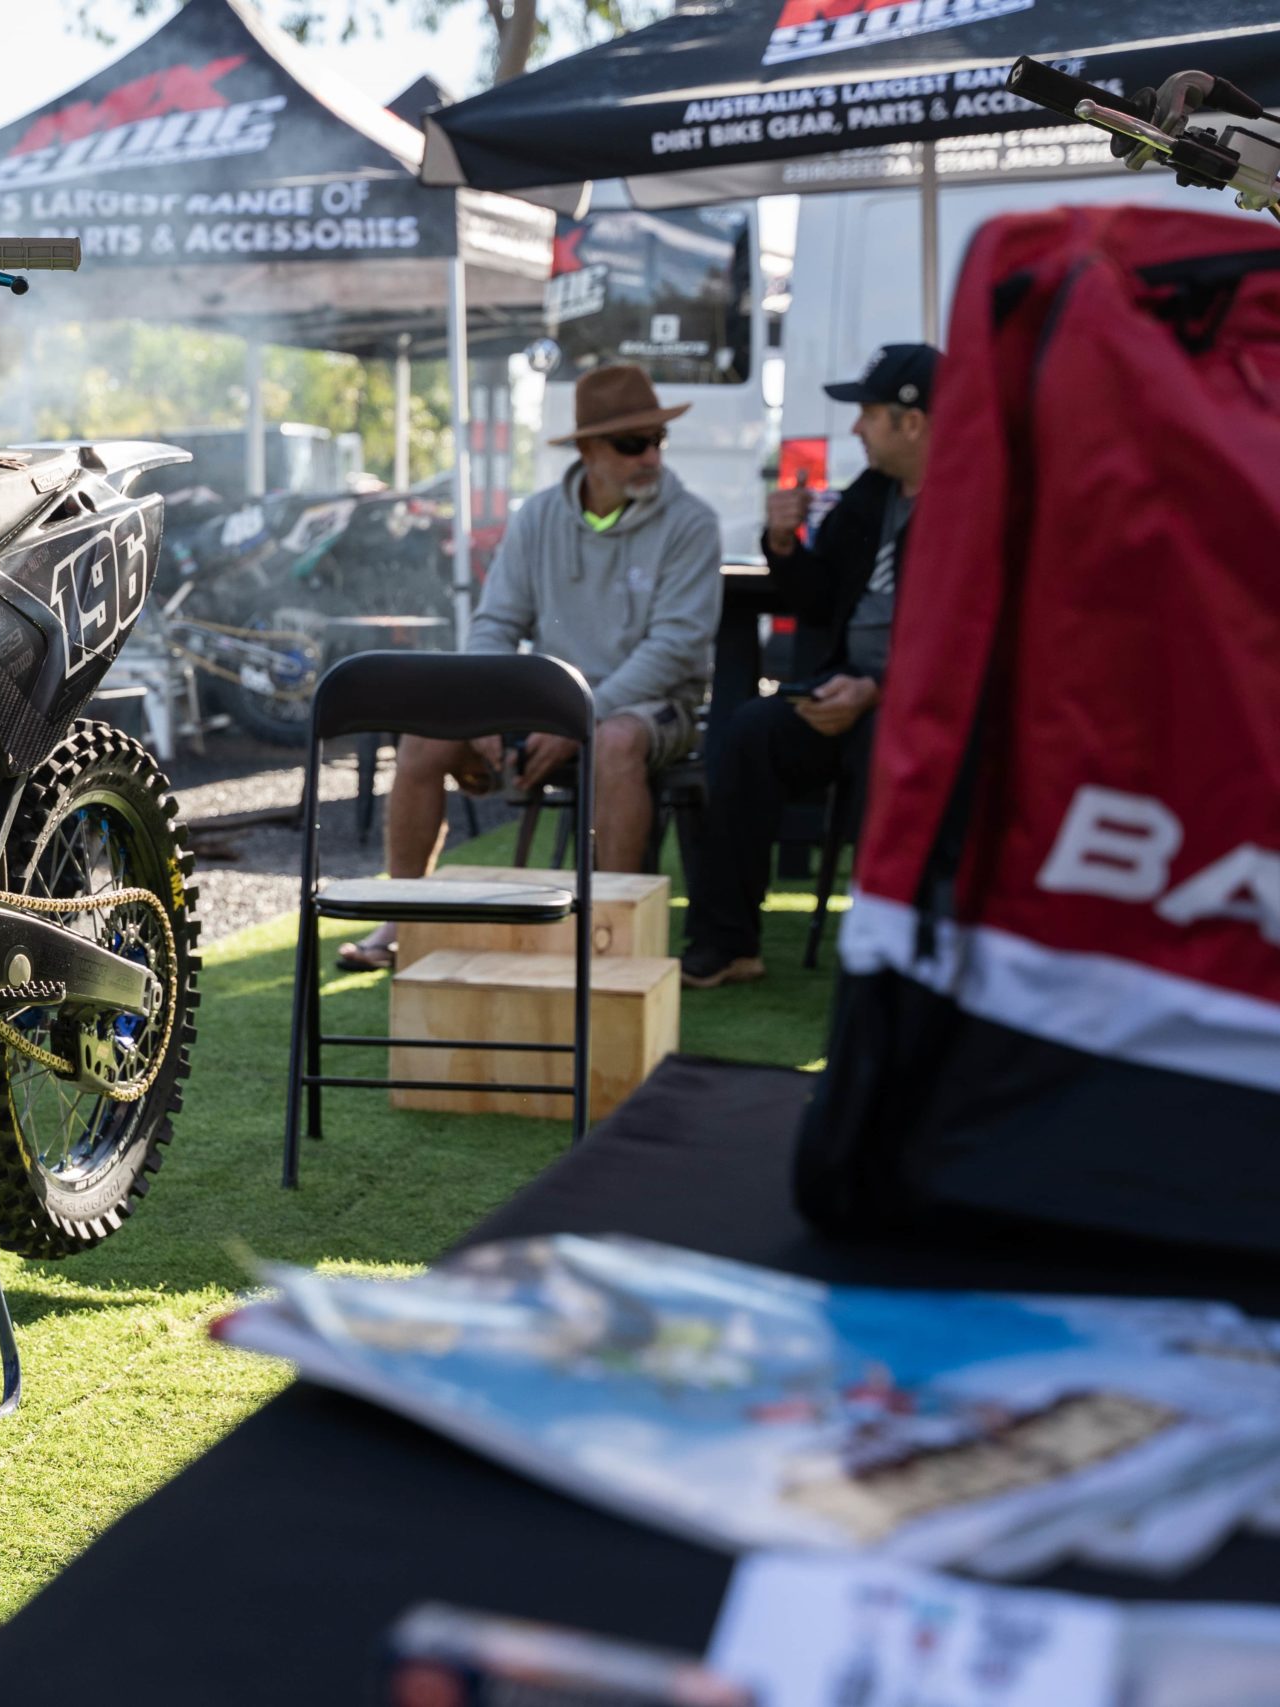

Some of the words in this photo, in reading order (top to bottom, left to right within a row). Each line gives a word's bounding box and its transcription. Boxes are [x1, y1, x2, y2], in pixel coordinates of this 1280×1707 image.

[683, 84, 837, 124] AUSTRALIA'S
[841, 73, 951, 104] LARGEST
[652, 126, 706, 155] DIRT
[708, 119, 764, 147] BIKE
[767, 110, 843, 140] GEAR,
[847, 99, 925, 131] PARTS
[929, 97, 950, 122] &
[32, 188, 180, 219] LARGEST
[184, 186, 314, 217] RANGE
[322, 180, 371, 215] OF
[150, 222, 176, 253] &
[185, 215, 420, 253] ACCESSORIES
[49, 507, 147, 681] 196
